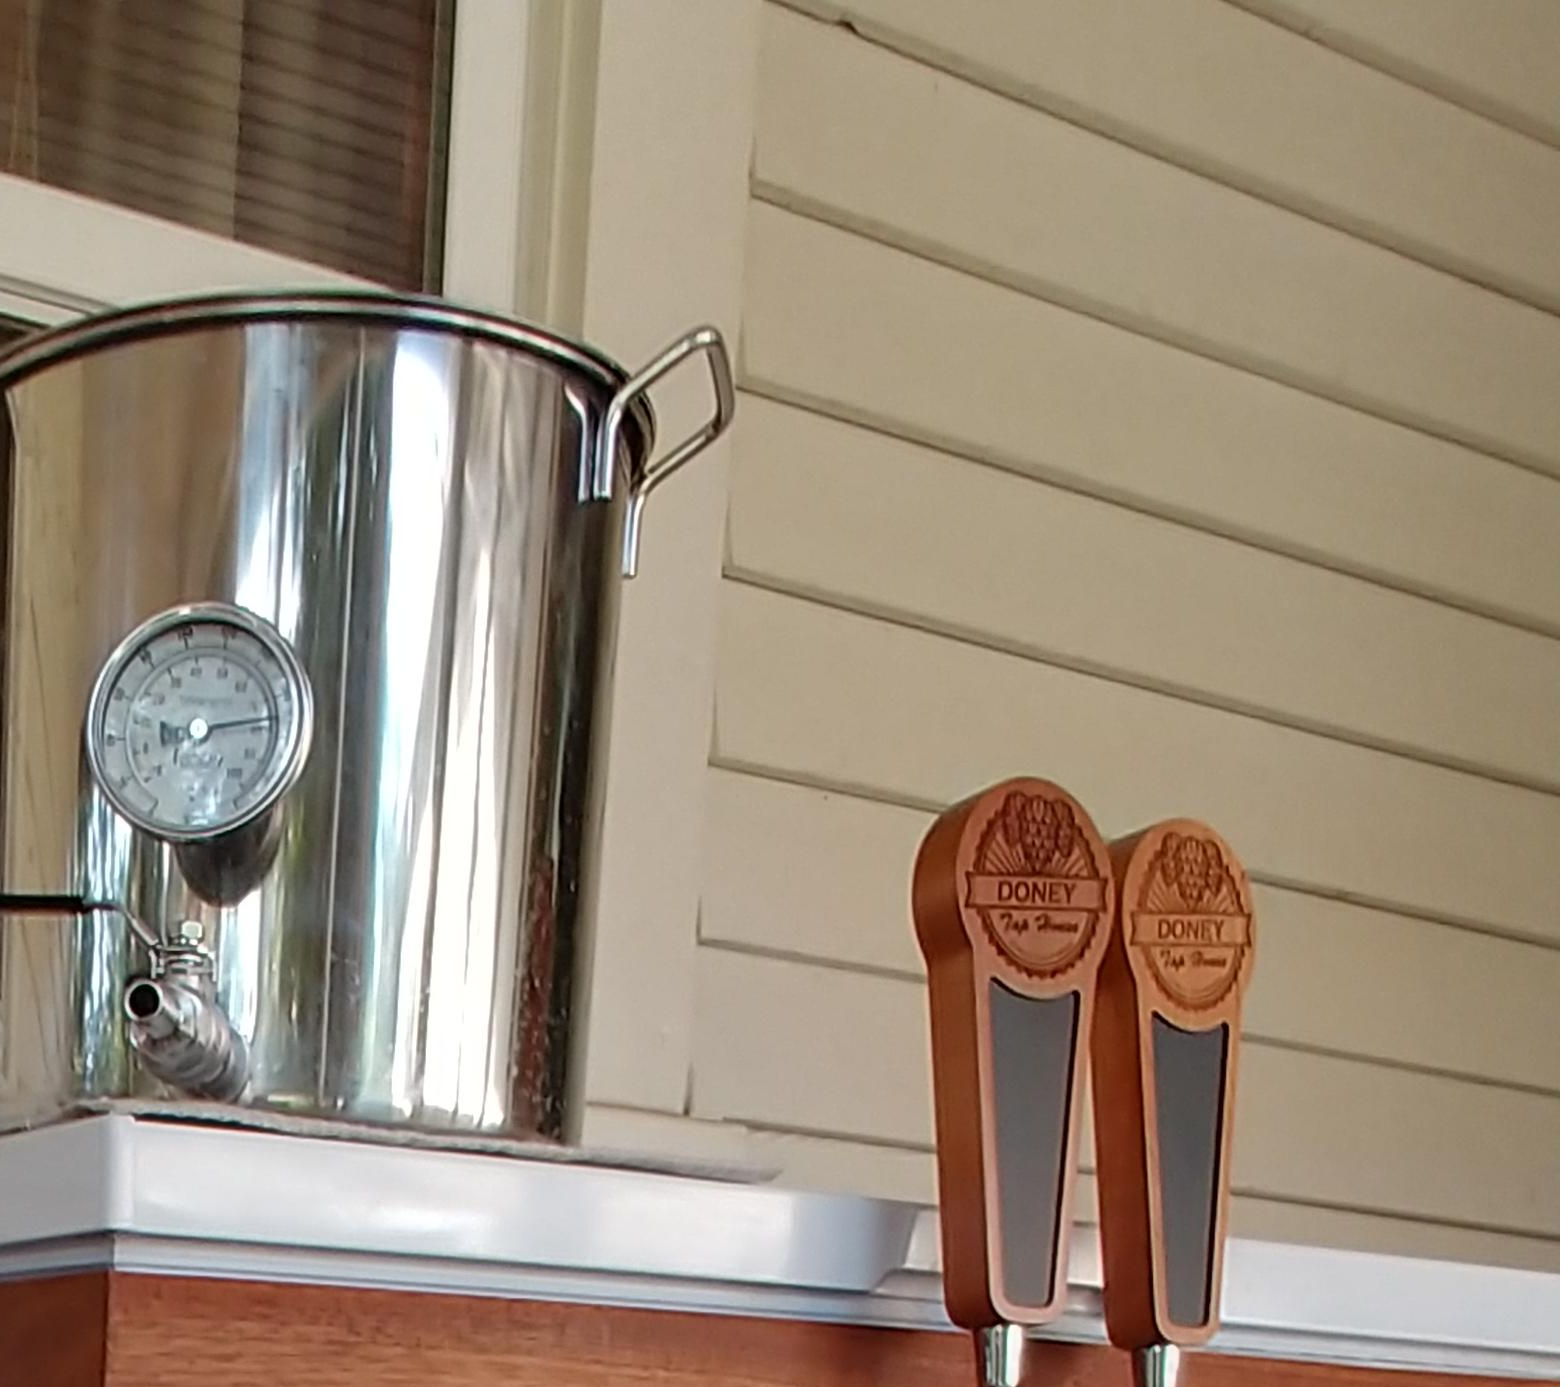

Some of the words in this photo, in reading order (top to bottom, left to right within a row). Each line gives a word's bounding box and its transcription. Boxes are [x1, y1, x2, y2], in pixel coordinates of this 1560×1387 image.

[997, 880, 1078, 904] DONEY
[999, 912, 1031, 935] Tap
[1157, 918, 1226, 941] DONEY
